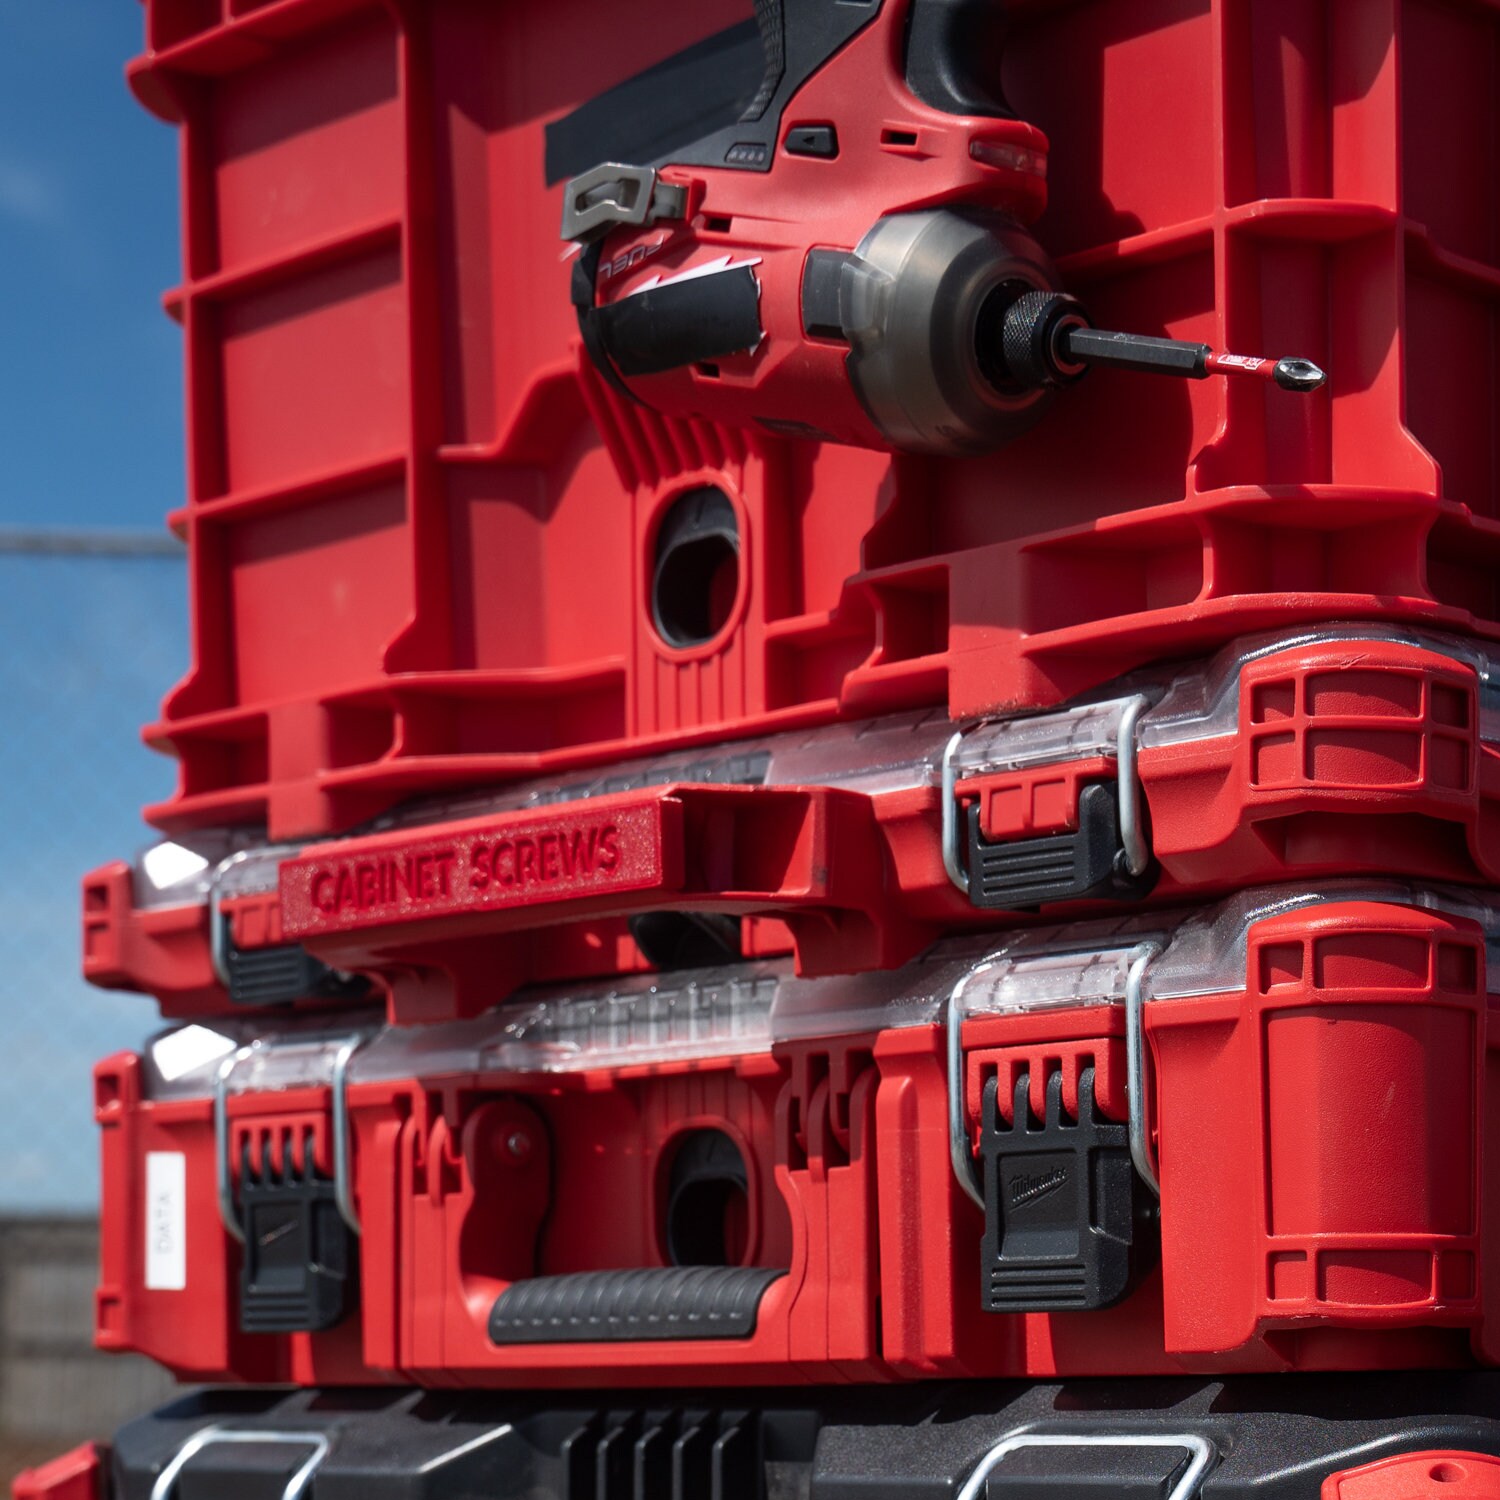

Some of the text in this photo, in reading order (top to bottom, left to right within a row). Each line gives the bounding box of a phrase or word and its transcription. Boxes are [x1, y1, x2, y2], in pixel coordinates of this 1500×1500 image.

[597, 234, 664, 279] FUEL
[310, 824, 619, 914] CABINET SCREWS
